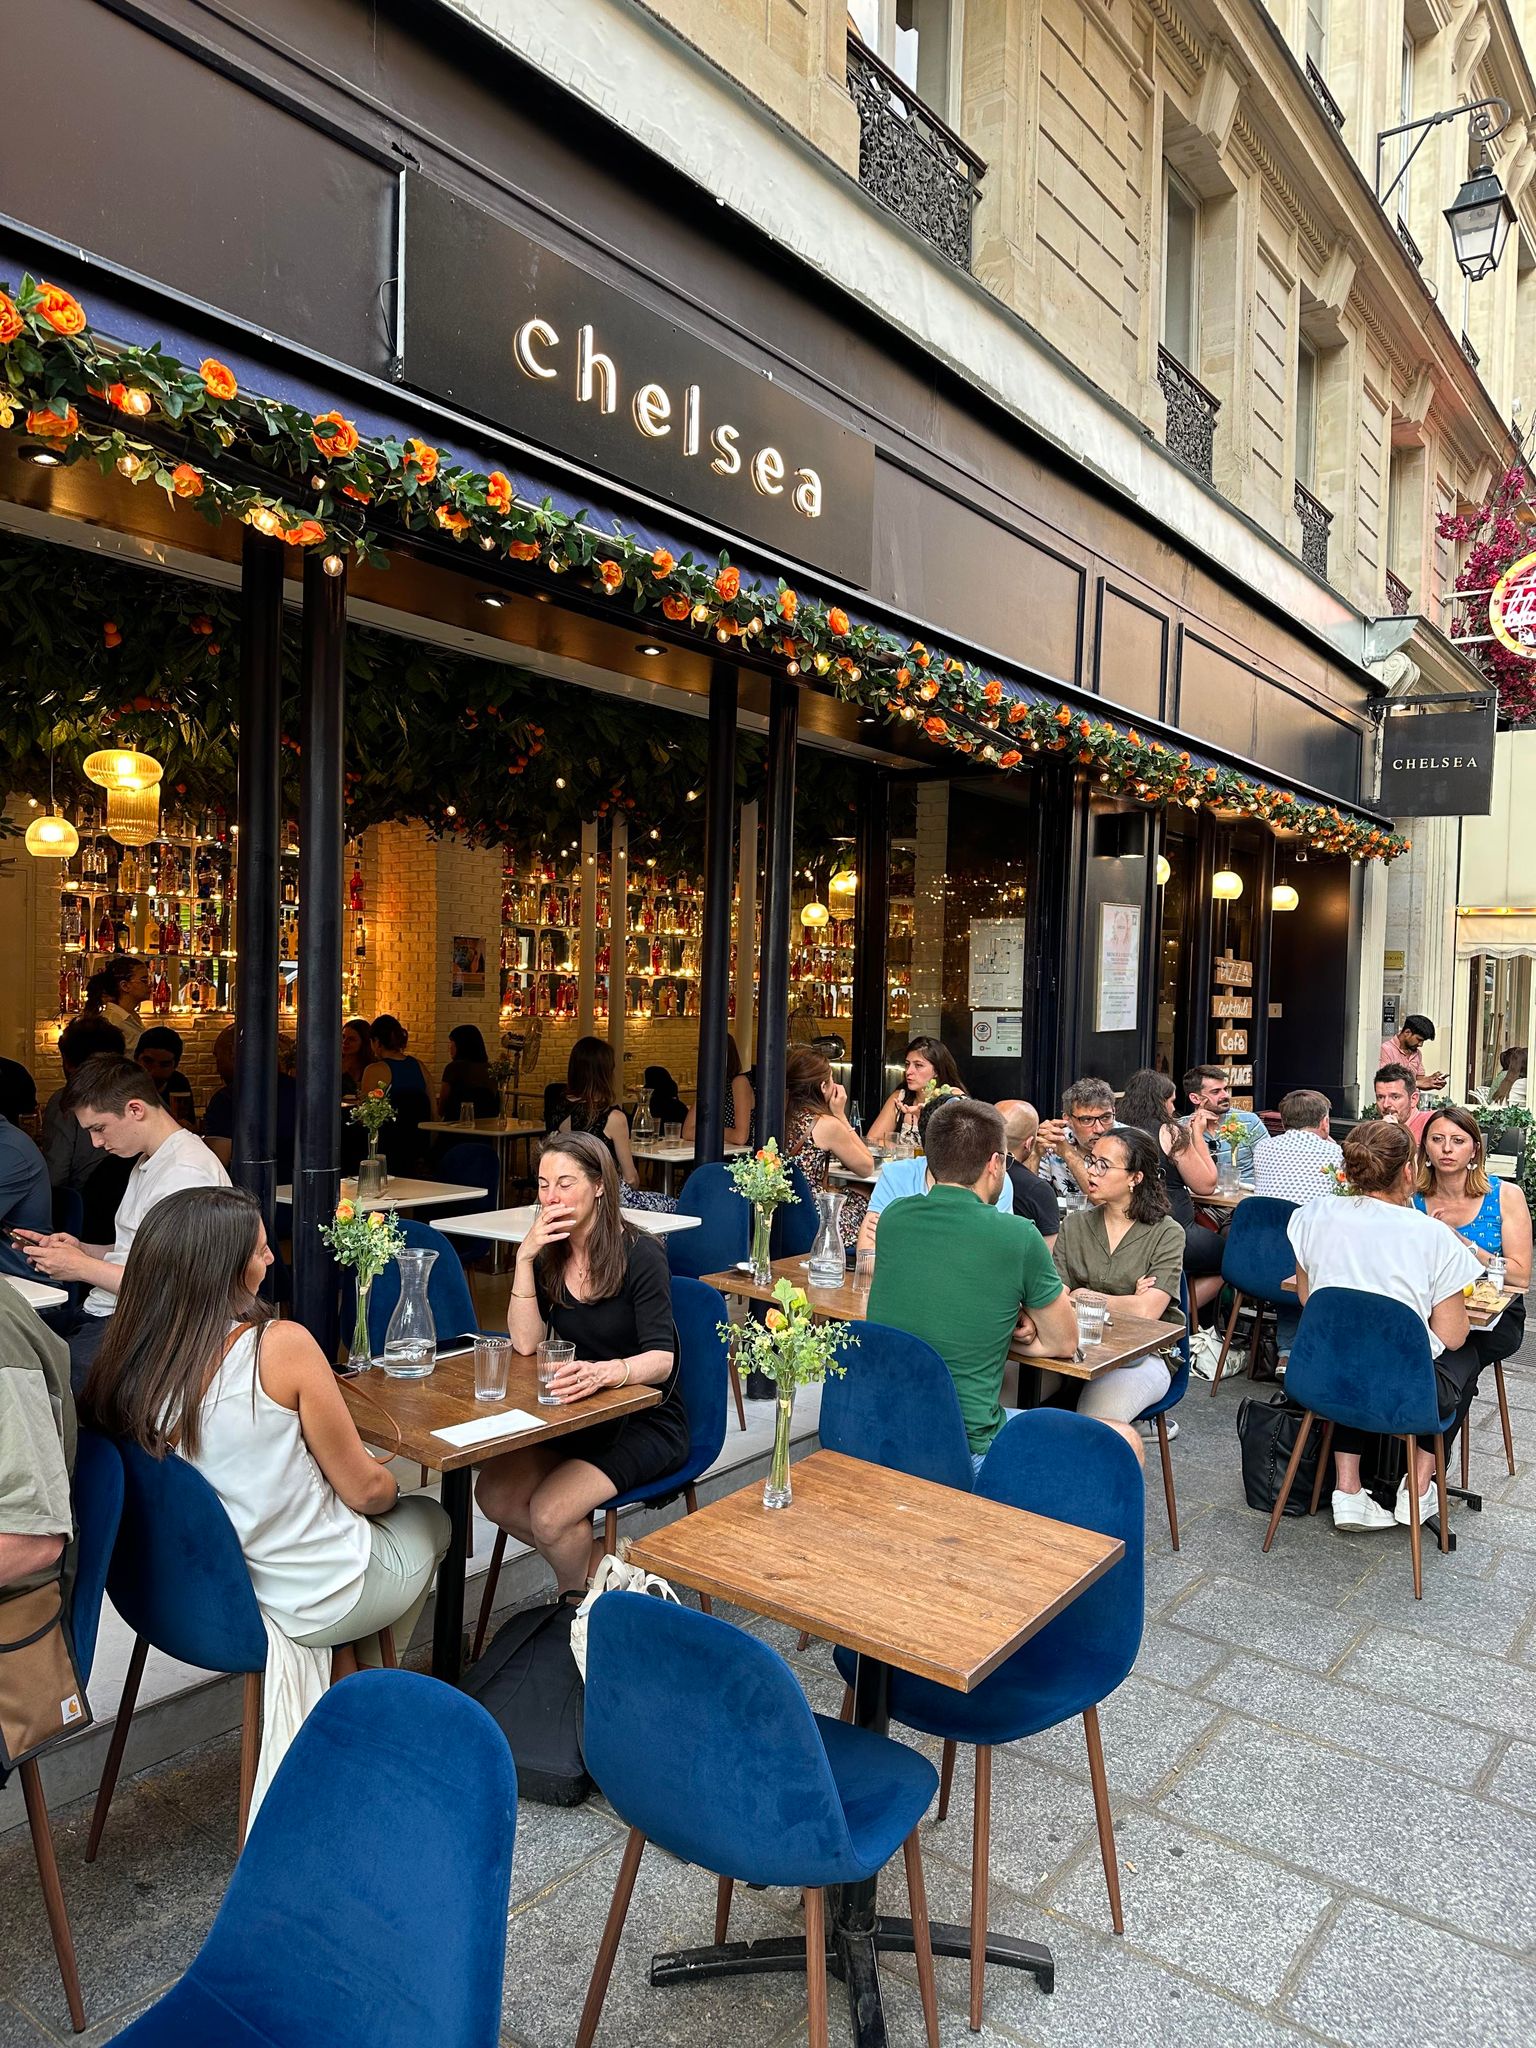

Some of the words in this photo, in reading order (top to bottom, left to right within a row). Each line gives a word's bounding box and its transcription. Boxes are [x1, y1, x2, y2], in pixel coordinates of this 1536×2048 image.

[513, 318, 822, 517] chelsea
[1392, 756, 1478, 770] CHELSEA
[1220, 961, 1249, 982] PIZZA
[1230, 1067, 1252, 1084] PLACE
